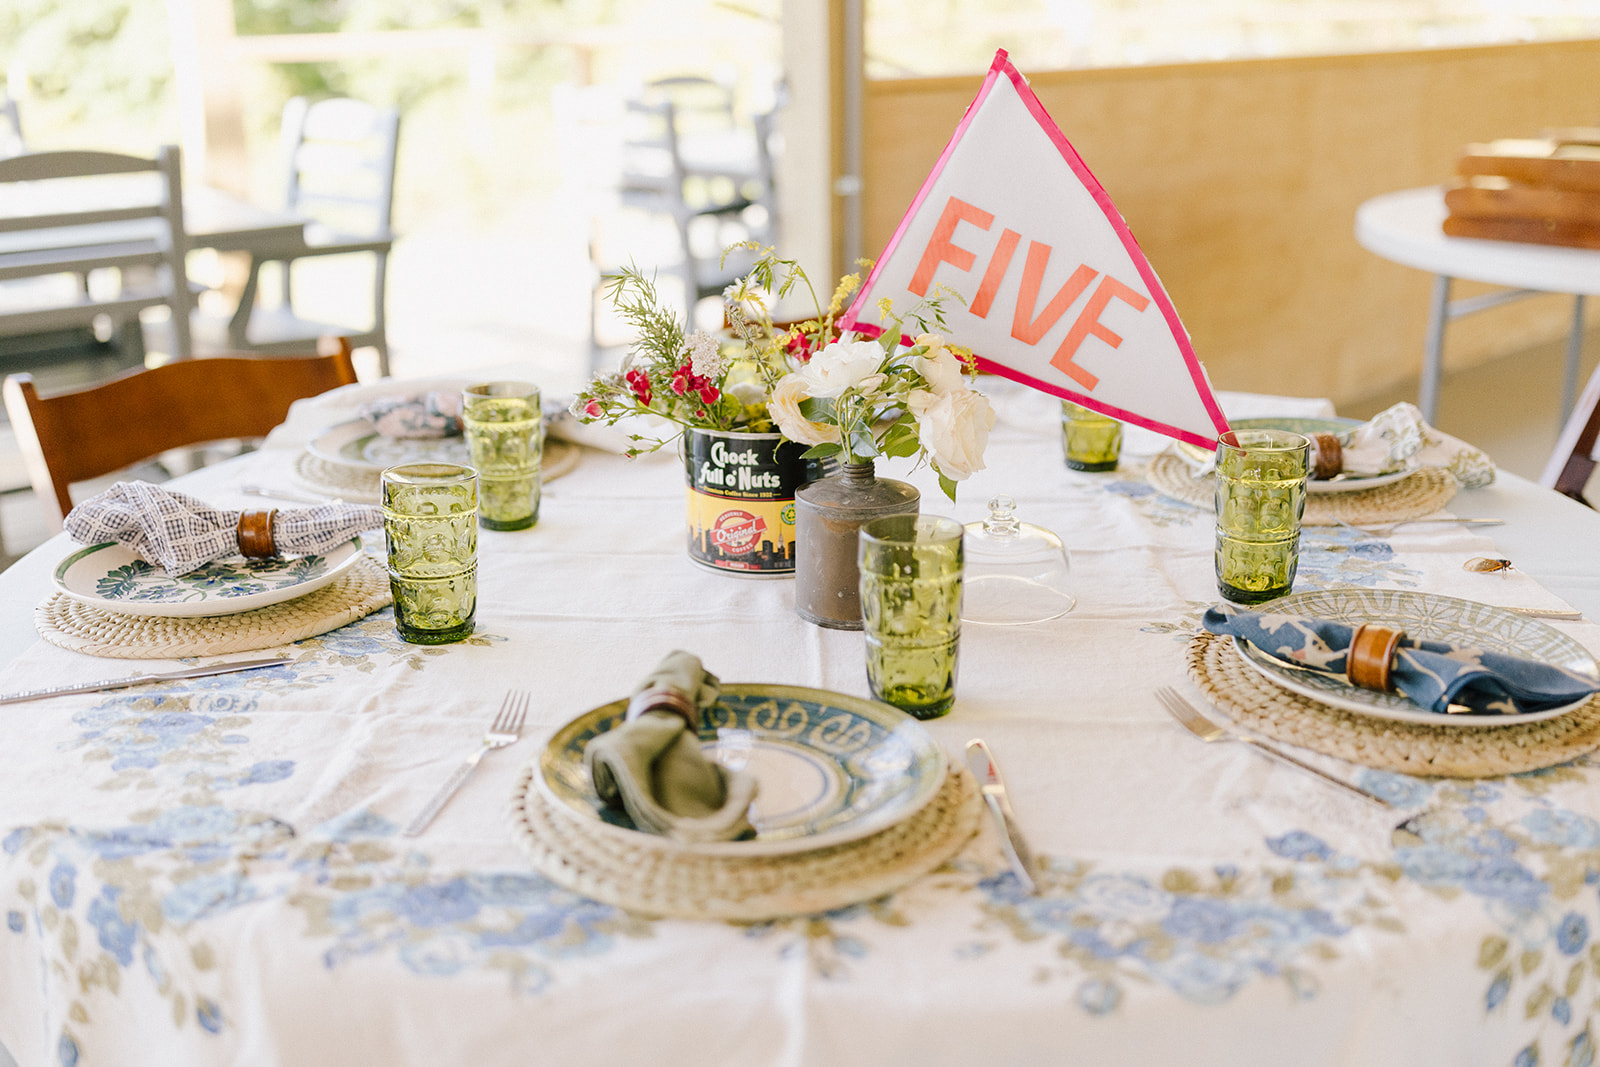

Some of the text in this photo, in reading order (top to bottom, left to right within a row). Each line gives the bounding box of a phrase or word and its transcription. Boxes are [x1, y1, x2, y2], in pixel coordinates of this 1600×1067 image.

[907, 196, 1150, 392] FIVE
[711, 441, 759, 468] Chock
[698, 461, 724, 485] full
[738, 466, 781, 490] Nuts
[716, 520, 756, 542] Original
[731, 542, 754, 553] COFFEE
